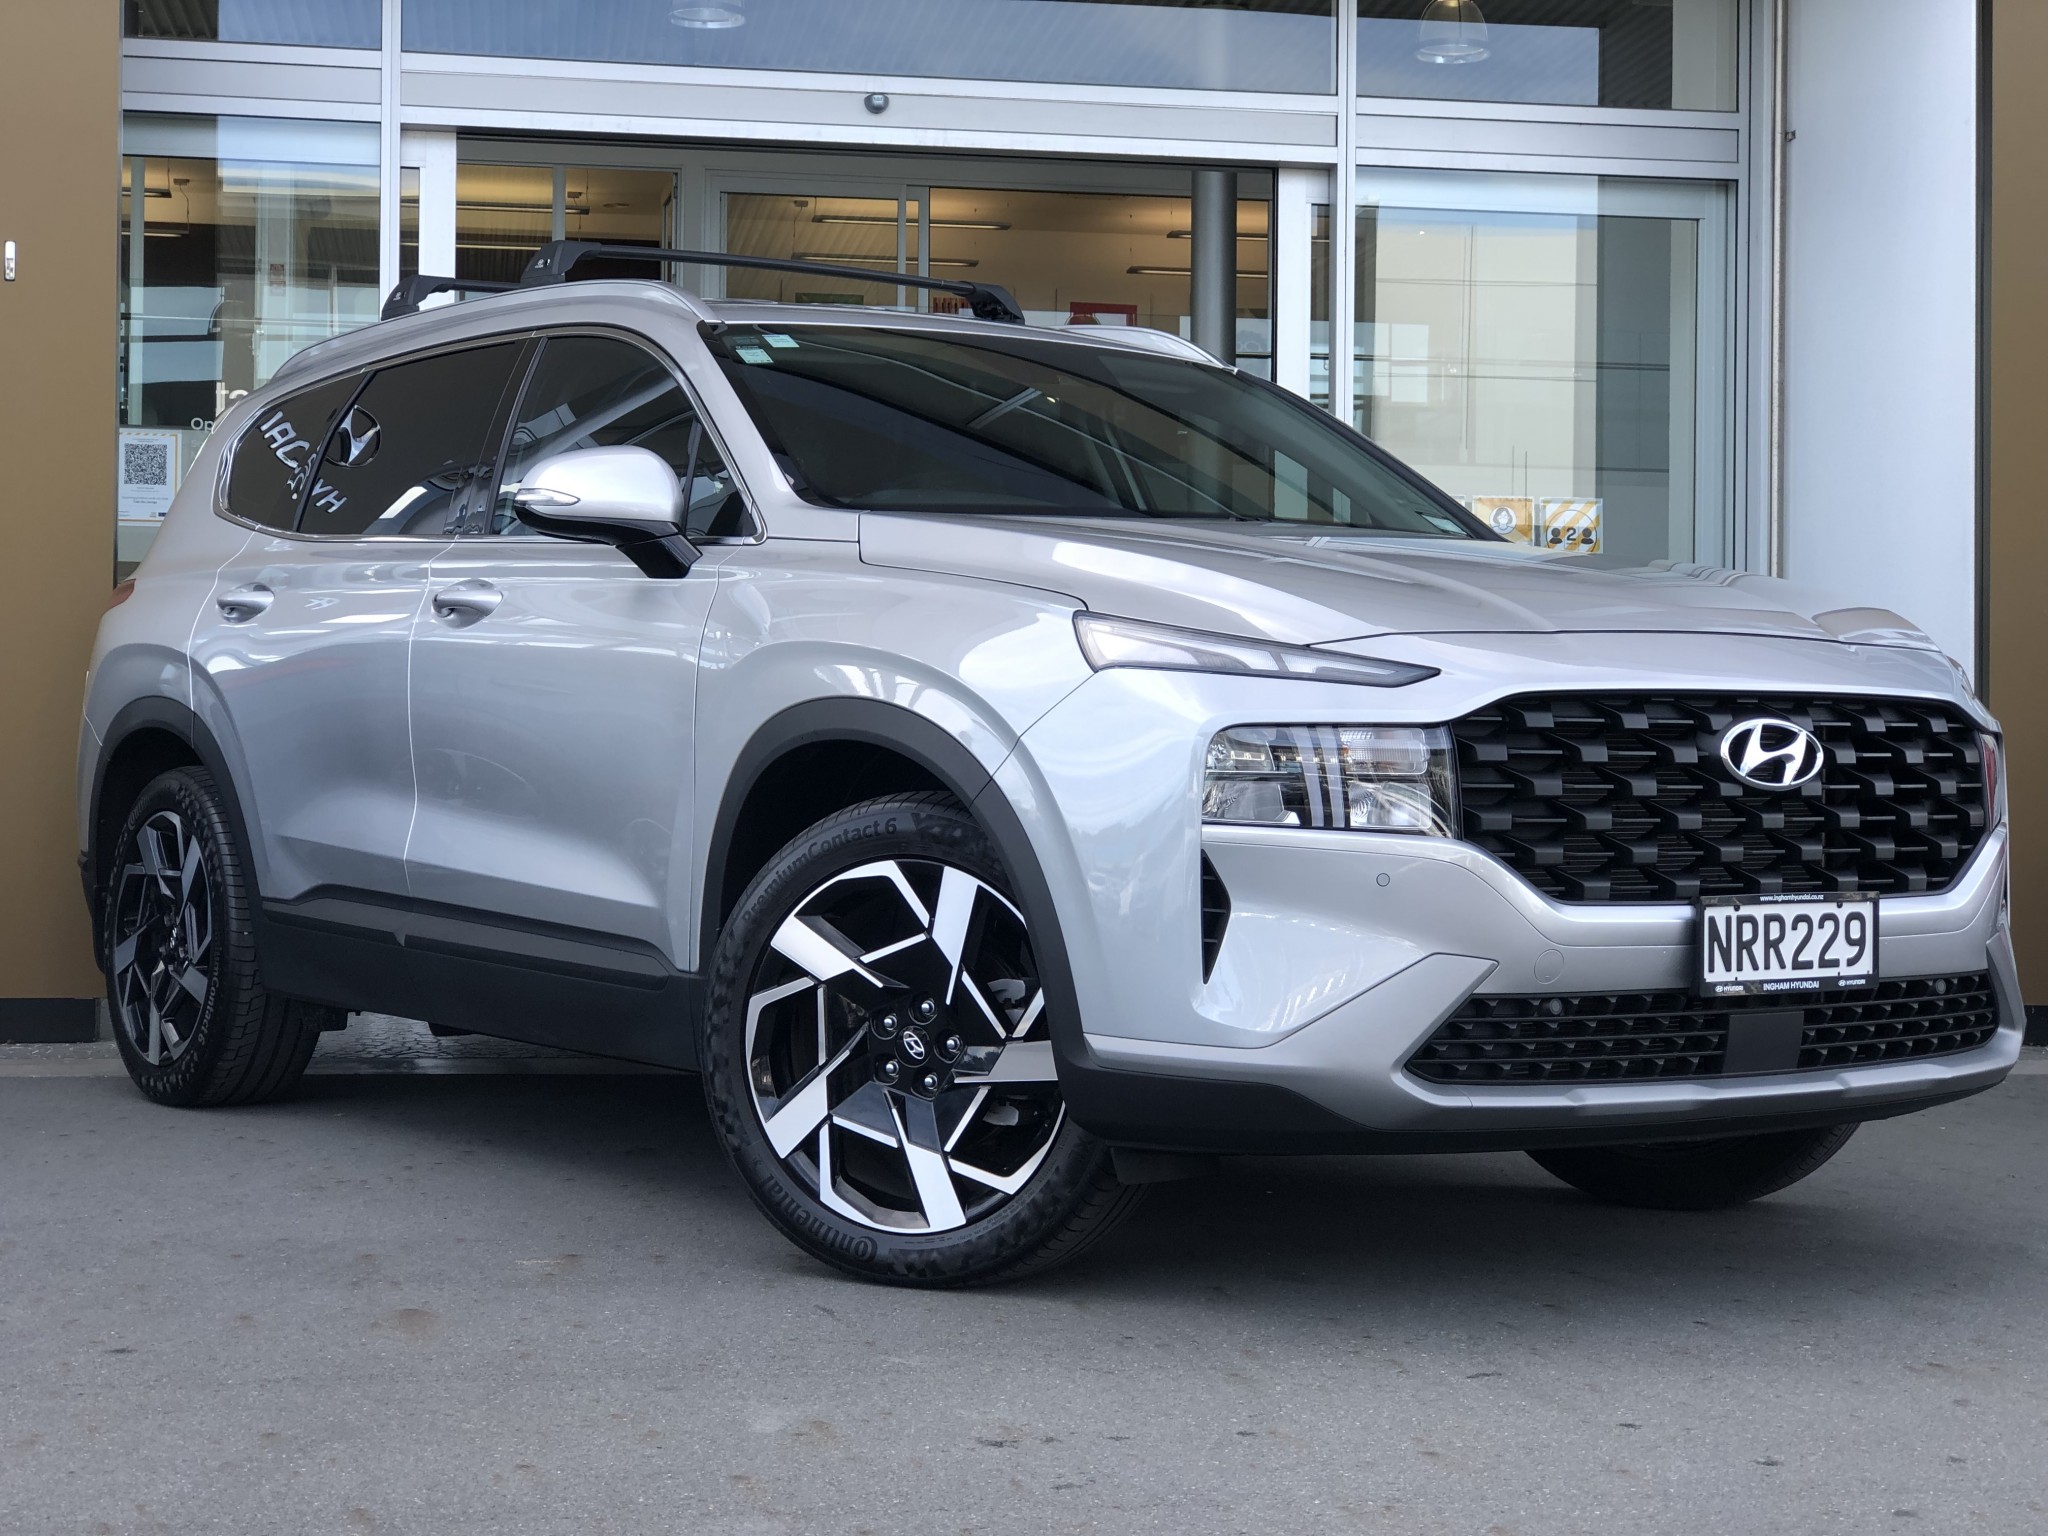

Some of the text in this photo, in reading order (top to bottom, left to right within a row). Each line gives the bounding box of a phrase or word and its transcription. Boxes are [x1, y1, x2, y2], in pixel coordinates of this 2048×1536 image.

[1566, 527, 1577, 541] 2
[742, 817, 898, 928] PremiumContact 6
[1760, 893, 1824, 902] www.inghamhyundai.co.nz
[1708, 911, 1867, 973] NRR229
[1763, 980, 1819, 991] INGHAM HYUNDAI
[758, 1174, 878, 1263] Continental
